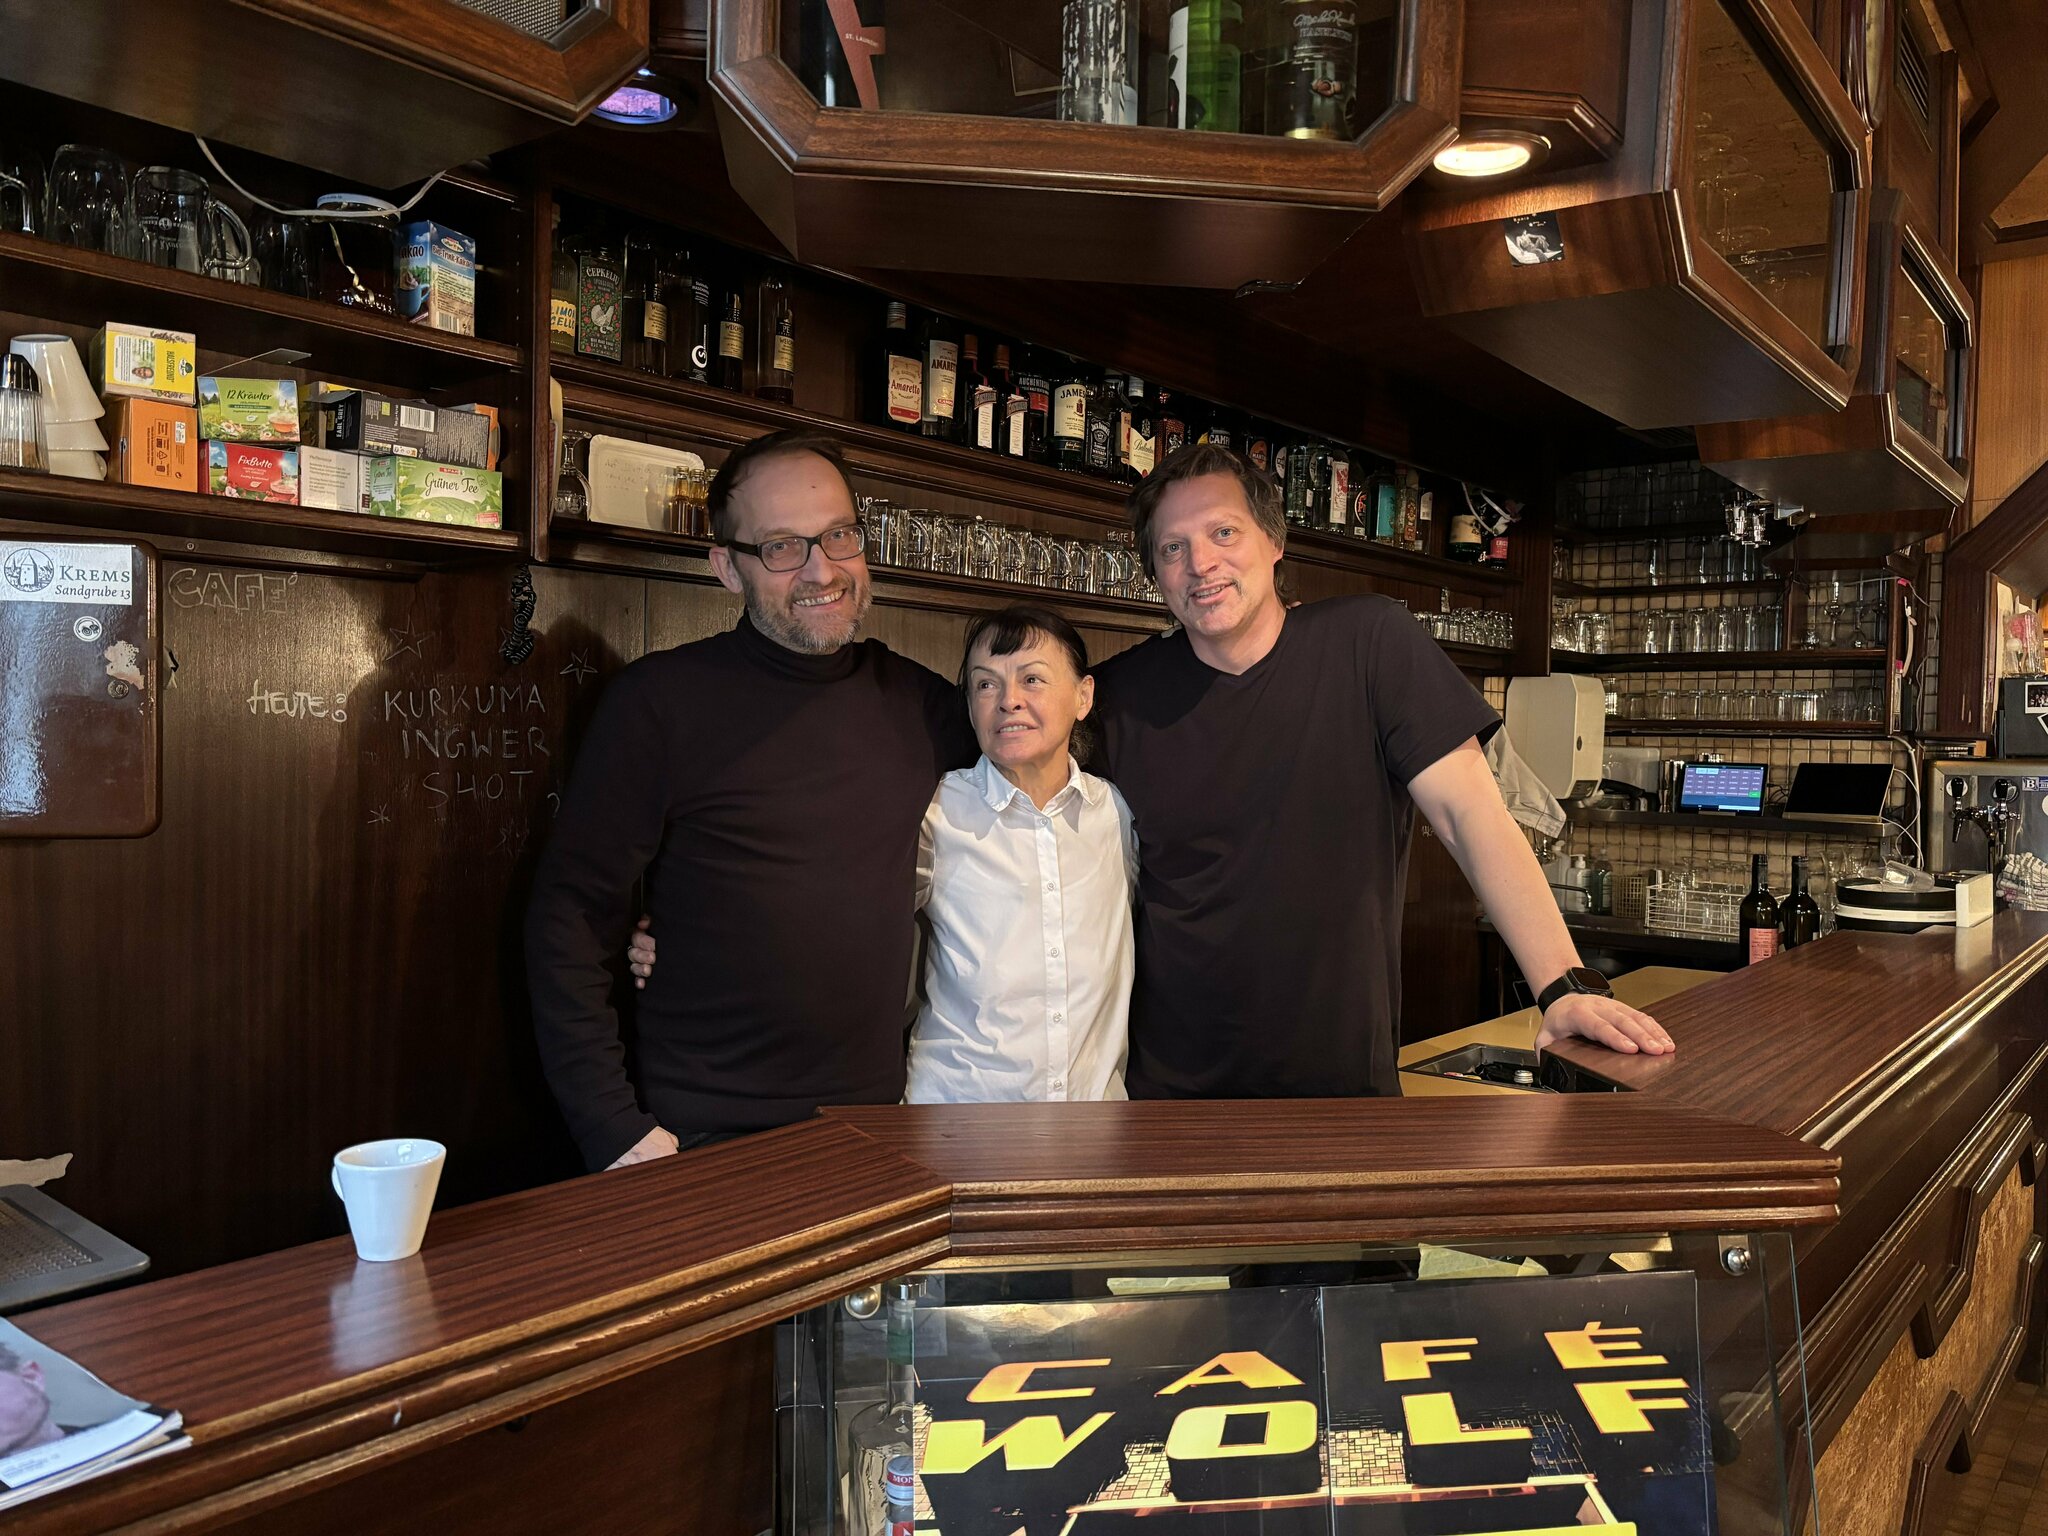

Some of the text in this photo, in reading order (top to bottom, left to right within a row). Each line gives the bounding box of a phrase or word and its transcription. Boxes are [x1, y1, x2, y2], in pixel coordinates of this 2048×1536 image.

[226, 389, 272, 401] 12 Kräuter
[891, 380, 920, 394] Amaretto
[337, 404, 345, 420] GREY
[425, 472, 479, 496] Grüner Tee
[55, 585, 131, 600] Sandgrube 13
[384, 684, 546, 722] KURKUMA
[402, 724, 551, 760] INGWER
[422, 770, 534, 809] SHOT
[919, 1378, 1690, 1475] WOLF
